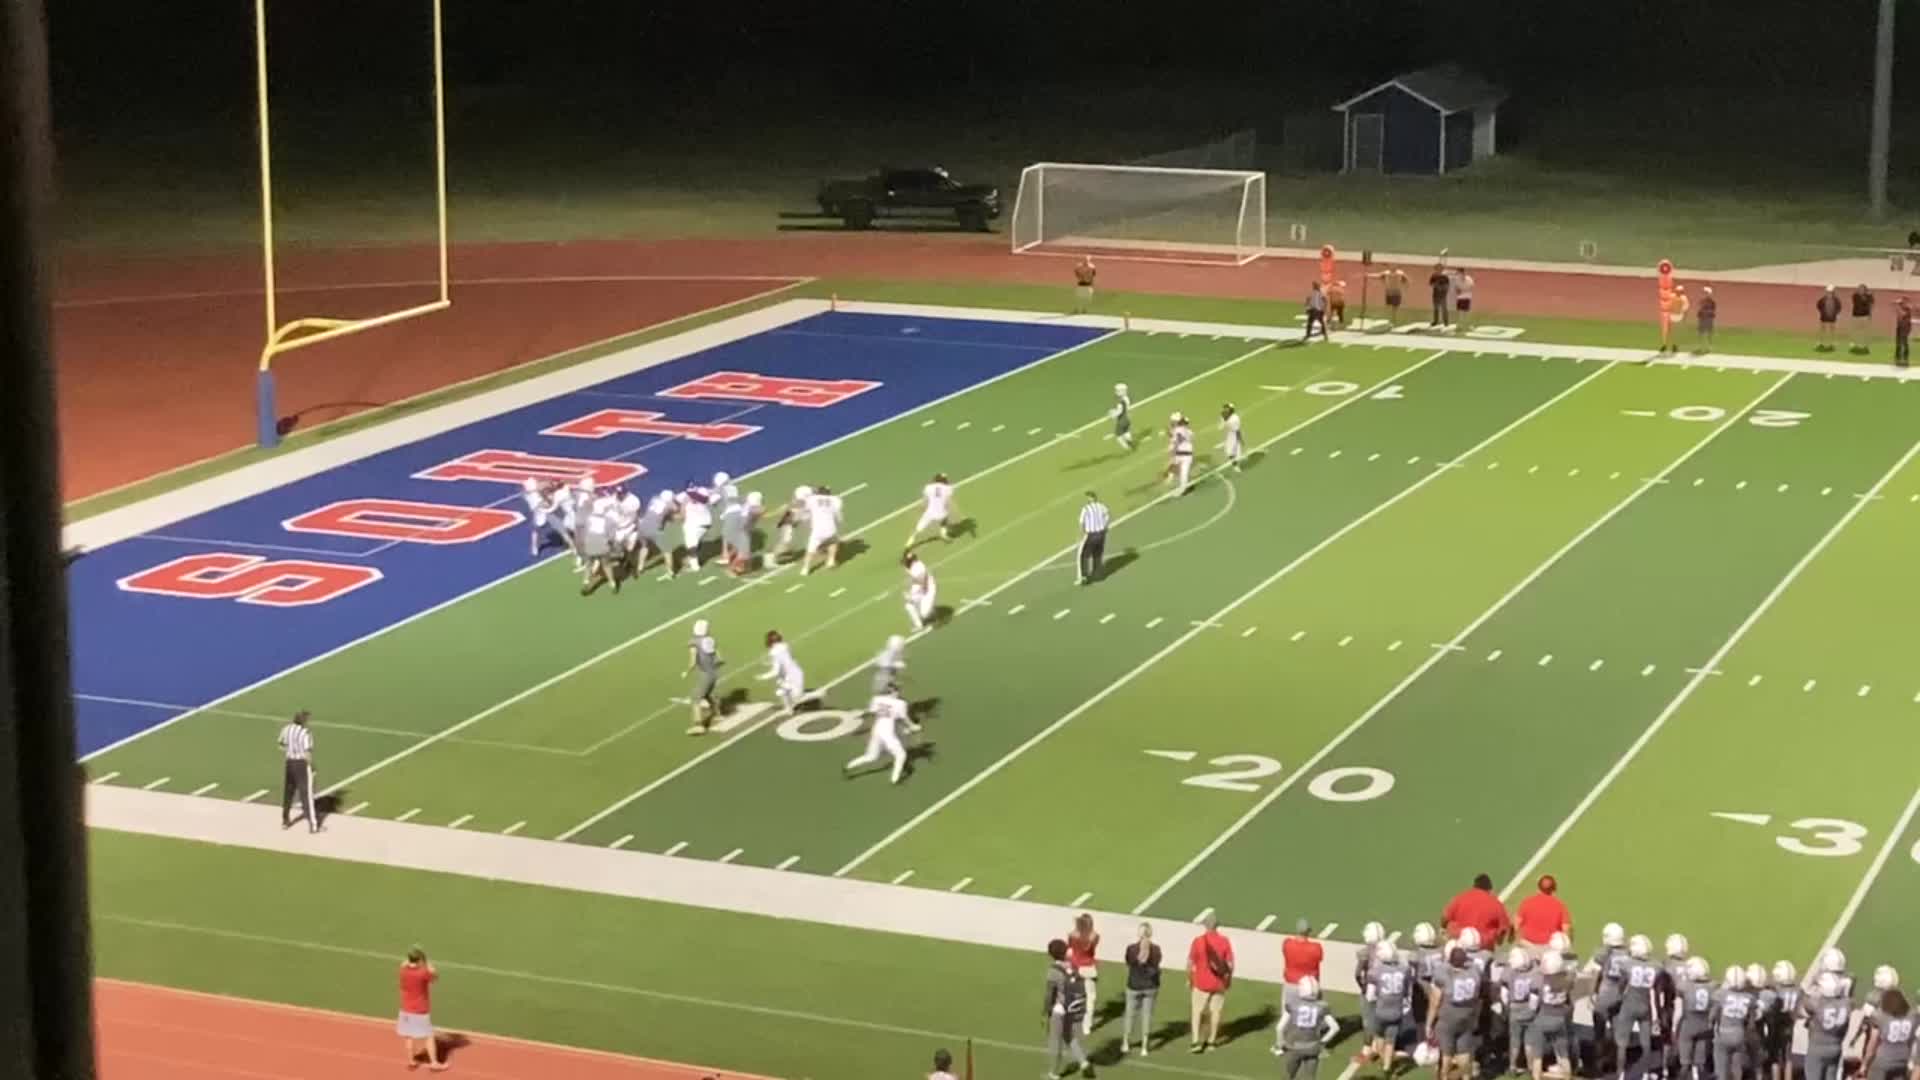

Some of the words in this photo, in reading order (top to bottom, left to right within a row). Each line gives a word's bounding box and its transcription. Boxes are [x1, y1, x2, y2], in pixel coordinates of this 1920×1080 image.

[1669, 405, 1812, 427] 20
[116, 371, 884, 607] SOUTH
[1181, 754, 1395, 802] 20
[1773, 817, 1920, 864] 3
[1296, 1006, 1319, 1027] 21
